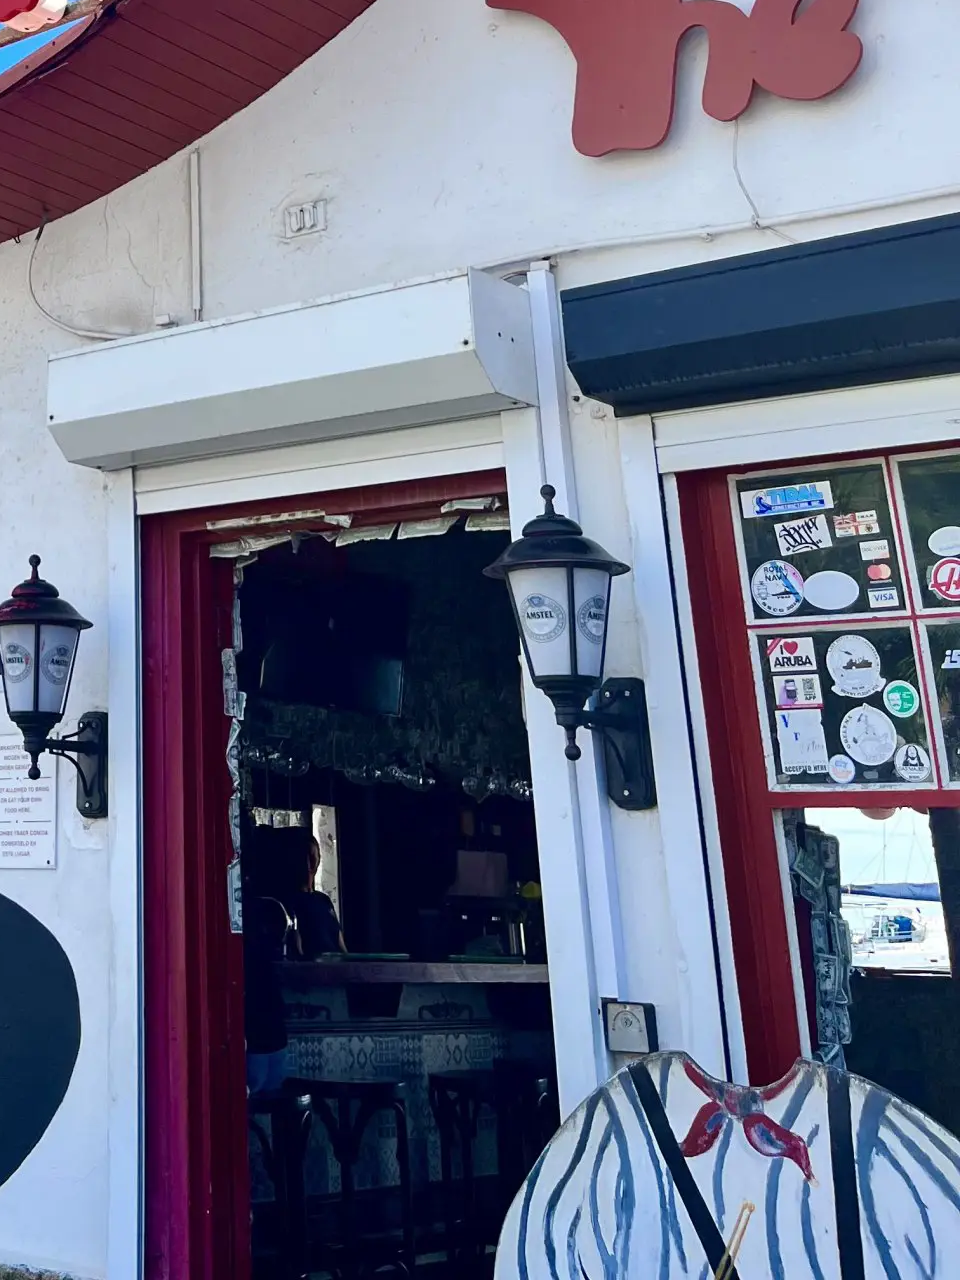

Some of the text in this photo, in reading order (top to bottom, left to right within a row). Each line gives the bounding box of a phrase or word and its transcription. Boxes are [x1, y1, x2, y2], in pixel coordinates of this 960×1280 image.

[766, 484, 824, 505] TIDAL
[763, 564, 788, 573] ROYAL
[765, 573, 789, 582] NAVY
[873, 592, 895, 602] VISA
[526, 610, 554, 620] AMSTEL
[780, 644, 784, 655] I
[774, 655, 813, 668] ARUBA
